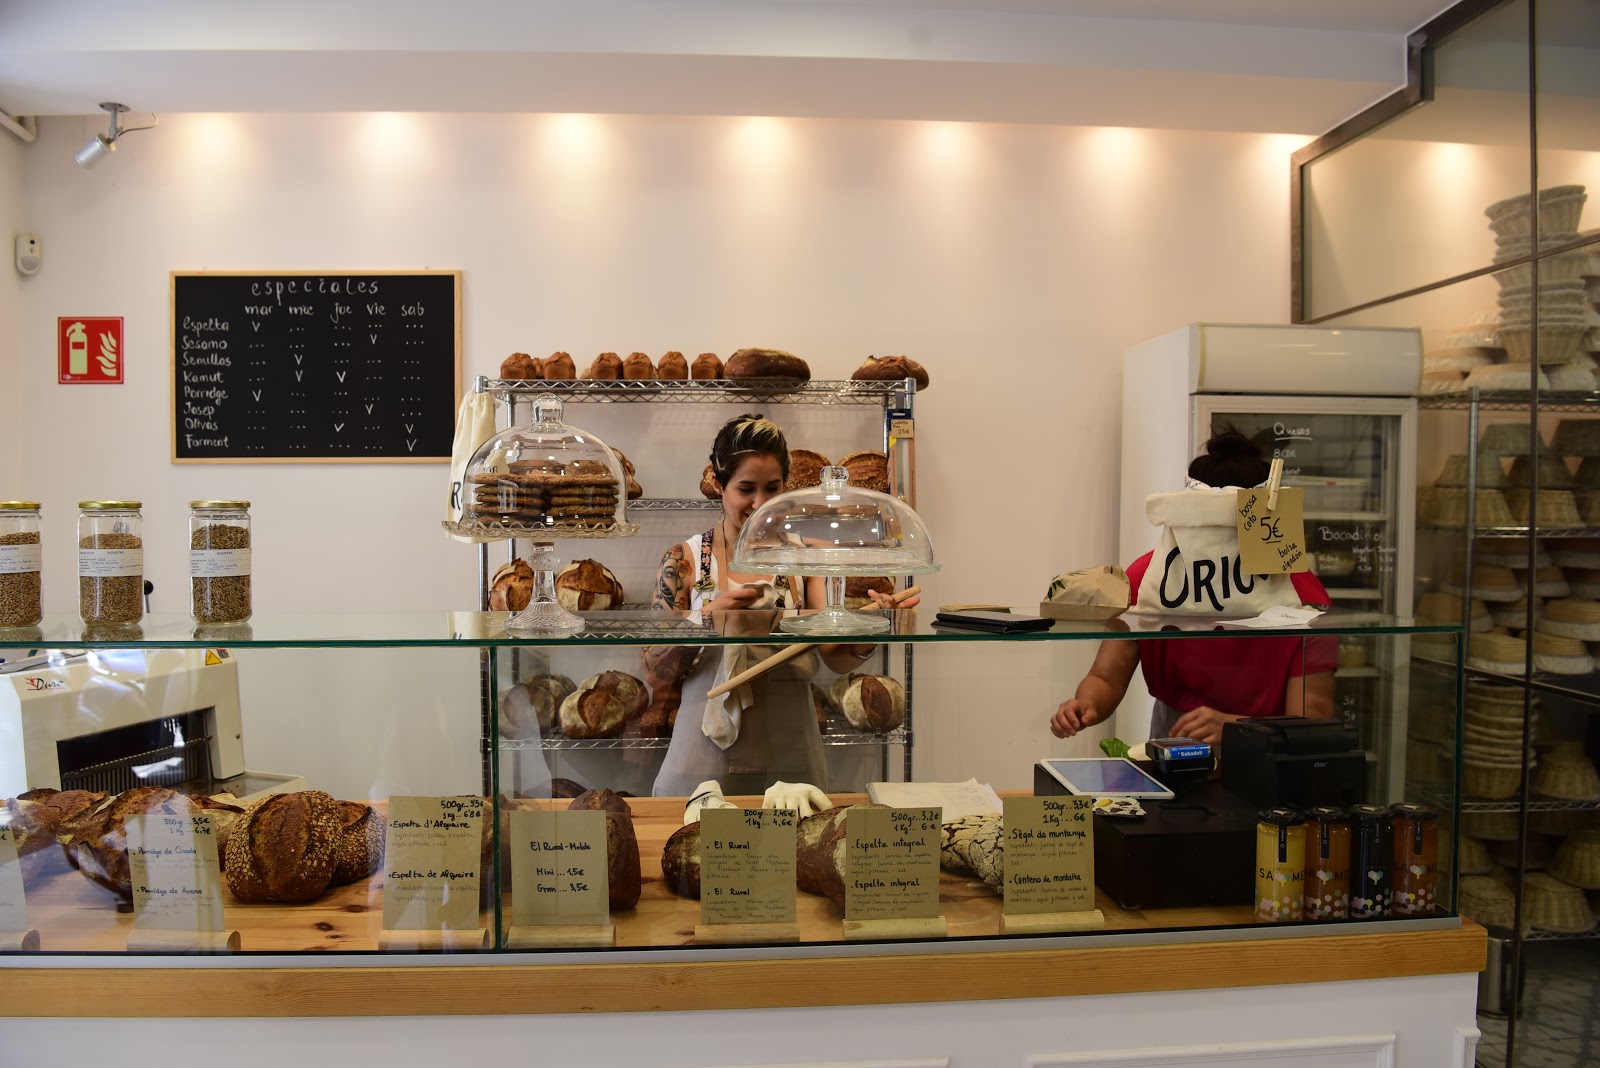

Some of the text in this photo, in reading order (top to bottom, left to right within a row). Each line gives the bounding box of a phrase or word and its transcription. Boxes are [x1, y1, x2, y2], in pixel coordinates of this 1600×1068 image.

[251, 278, 379, 306] especiales
[245, 304, 273, 315] mar
[330, 302, 352, 323] jue
[366, 302, 386, 316] vie
[401, 302, 424, 316] sab
[182, 335, 228, 351] Sesamo
[181, 352, 232, 367] Semillas
[183, 371, 224, 383] Kamut
[184, 385, 229, 405] Porridge
[183, 401, 215, 420] Josep
[184, 417, 219, 431] Olivas
[1273, 422, 1311, 437] Quesos
[185, 433, 229, 448] Forment
[1238, 494, 1258, 519] bossa
[1260, 516, 1284, 541] 5€
[1277, 541, 1298, 559] bolsa
[1281, 549, 1304, 572] algodón
[1072, 799, 1091, 811] 3,3€
[1073, 812, 1086, 822] 6€
[392, 820, 421, 830] Espelta
[1048, 829, 1087, 840] muntanya
[137, 845, 197, 858] Porridge de Civada
[529, 840, 541, 851] El
[714, 840, 750, 850] El Rural
[855, 837, 926, 853] Espelta integral
[391, 869, 475, 880] Espelta de Alguaire
[536, 867, 555, 877] Mini
[1013, 873, 1042, 884] Centeno
[1042, 874, 1052, 883] de
[140, 886, 203, 896] Porridge de Avena
[536, 882, 557, 894] Gran
[855, 877, 921, 891] Espelta integral
[714, 887, 750, 897] El Rural
